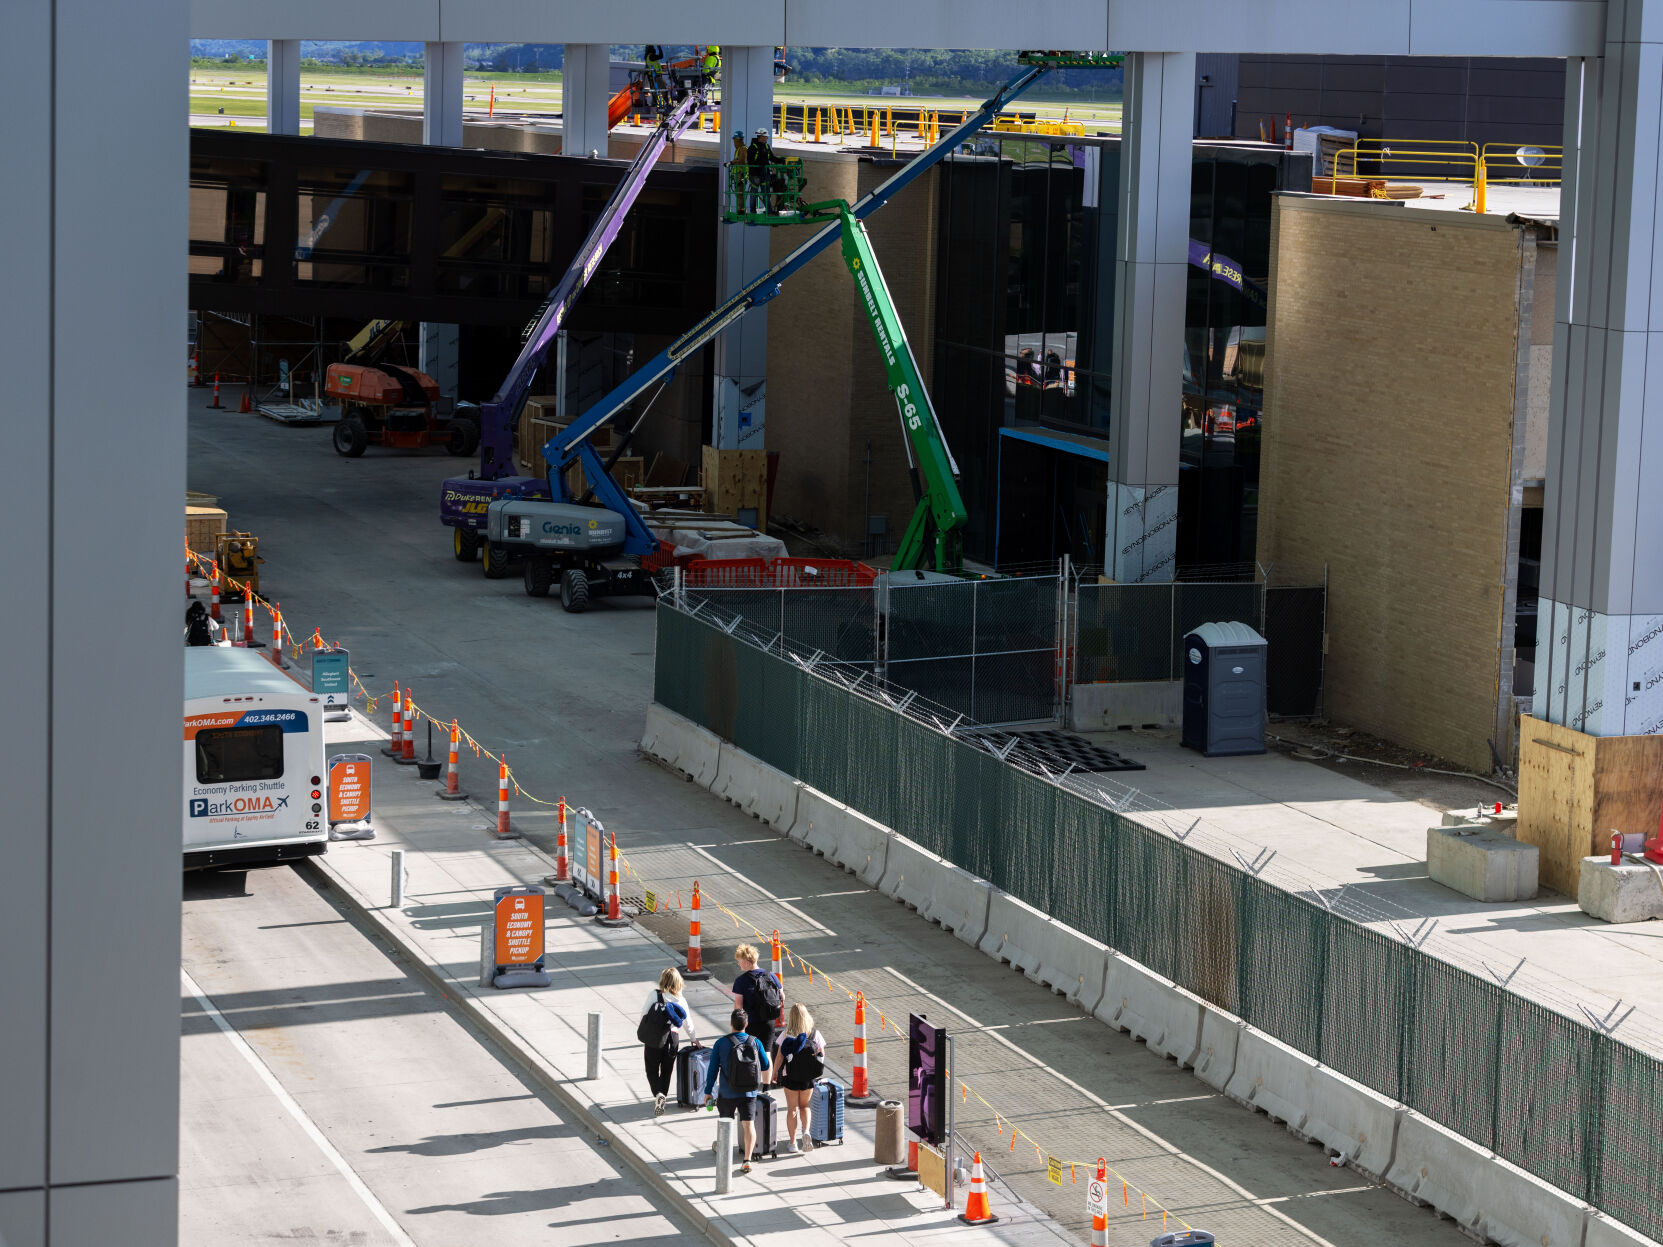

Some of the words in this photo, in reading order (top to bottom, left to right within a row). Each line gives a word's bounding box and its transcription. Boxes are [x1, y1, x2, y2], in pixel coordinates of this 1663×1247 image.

[857, 270, 878, 318] SUNBELT
[875, 317, 895, 366] RENTALS
[897, 383, 922, 431] S-65
[462, 502, 489, 514] JLG
[542, 521, 581, 536] Genie
[617, 571, 632, 579] 4x4
[244, 712, 296, 723] 402.346.2466
[193, 786, 228, 796] Economy
[229, 783, 258, 793] Parking
[259, 781, 285, 791] Shuttle
[193, 796, 274, 816] ParkOMA
[306, 821, 320, 830] 62
[511, 912, 529, 920] SOUTH
[507, 921, 532, 929] ECONOMY
[511, 929, 533, 937] CANOPY
[508, 938, 531, 946] SHUTTLE
